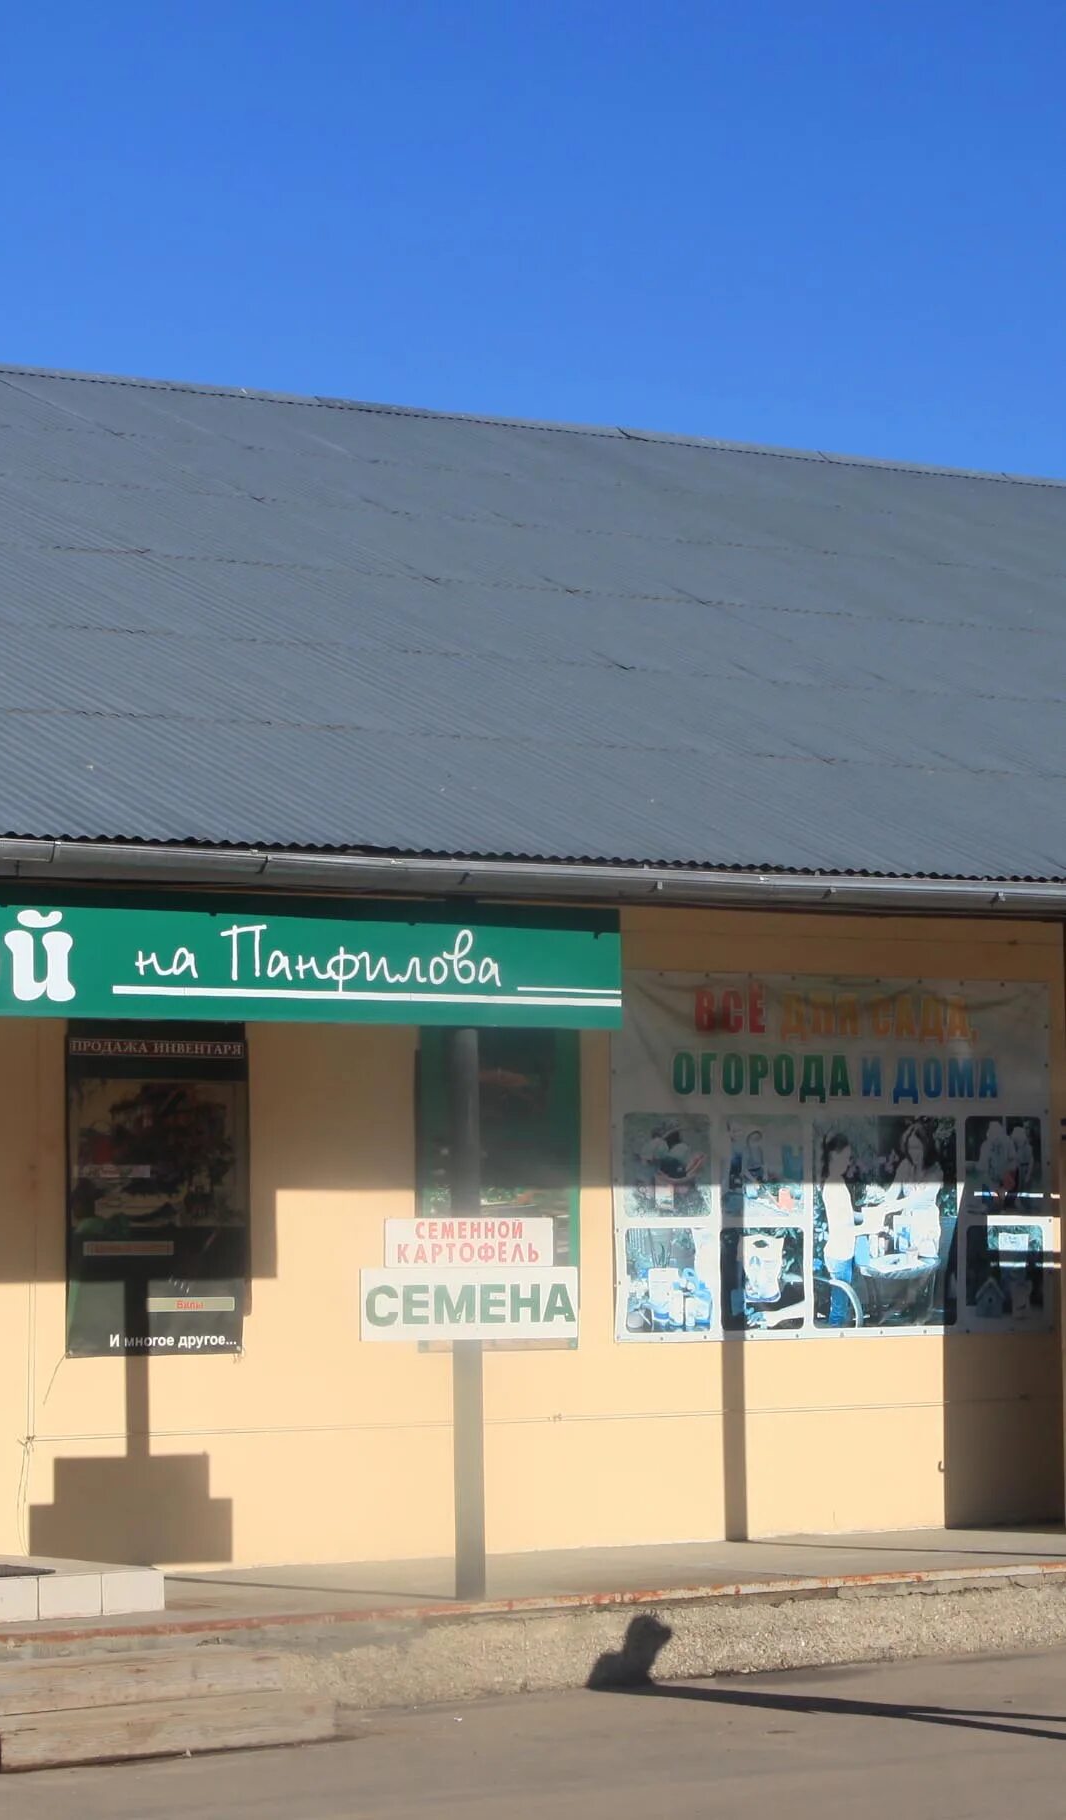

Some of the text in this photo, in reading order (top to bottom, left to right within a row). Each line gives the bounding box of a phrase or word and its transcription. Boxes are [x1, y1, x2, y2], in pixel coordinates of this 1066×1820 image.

[134, 946, 198, 980] на
[220, 924, 502, 992] Панфилова
[694, 983, 766, 1034] ВСЁ
[71, 1040, 242, 1056] ПРОДАЖА ИНВЕНТАРЯ
[672, 1051, 999, 1105] ОГОРОДА И ДОМА
[415, 1219, 524, 1240] СЕМЕННОЙ
[397, 1242, 540, 1264] КАРТОФЕЛЬ
[175, 1300, 204, 1310] Вилы
[365, 1283, 576, 1327] СЕМЕНА
[109, 1334, 237, 1350] И многое другое...
